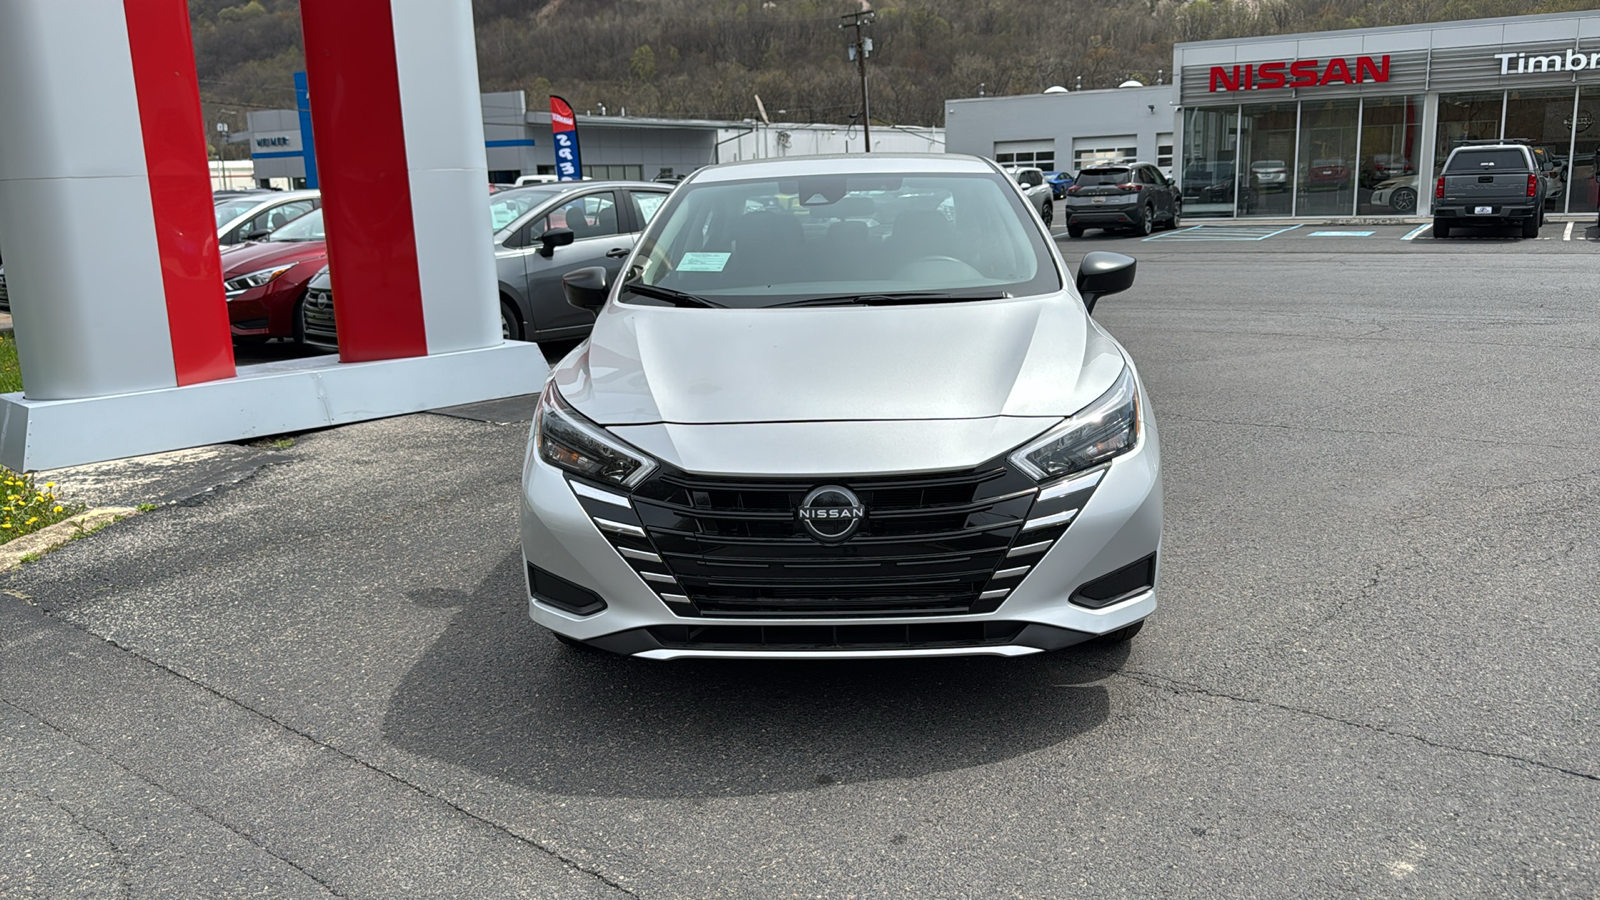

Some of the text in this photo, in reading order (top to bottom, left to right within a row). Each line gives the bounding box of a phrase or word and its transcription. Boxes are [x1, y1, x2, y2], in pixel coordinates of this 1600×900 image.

[1209, 55, 1390, 93] NISSAN
[1494, 48, 1600, 75] Timbr
[799, 508, 863, 518] NISSAN
